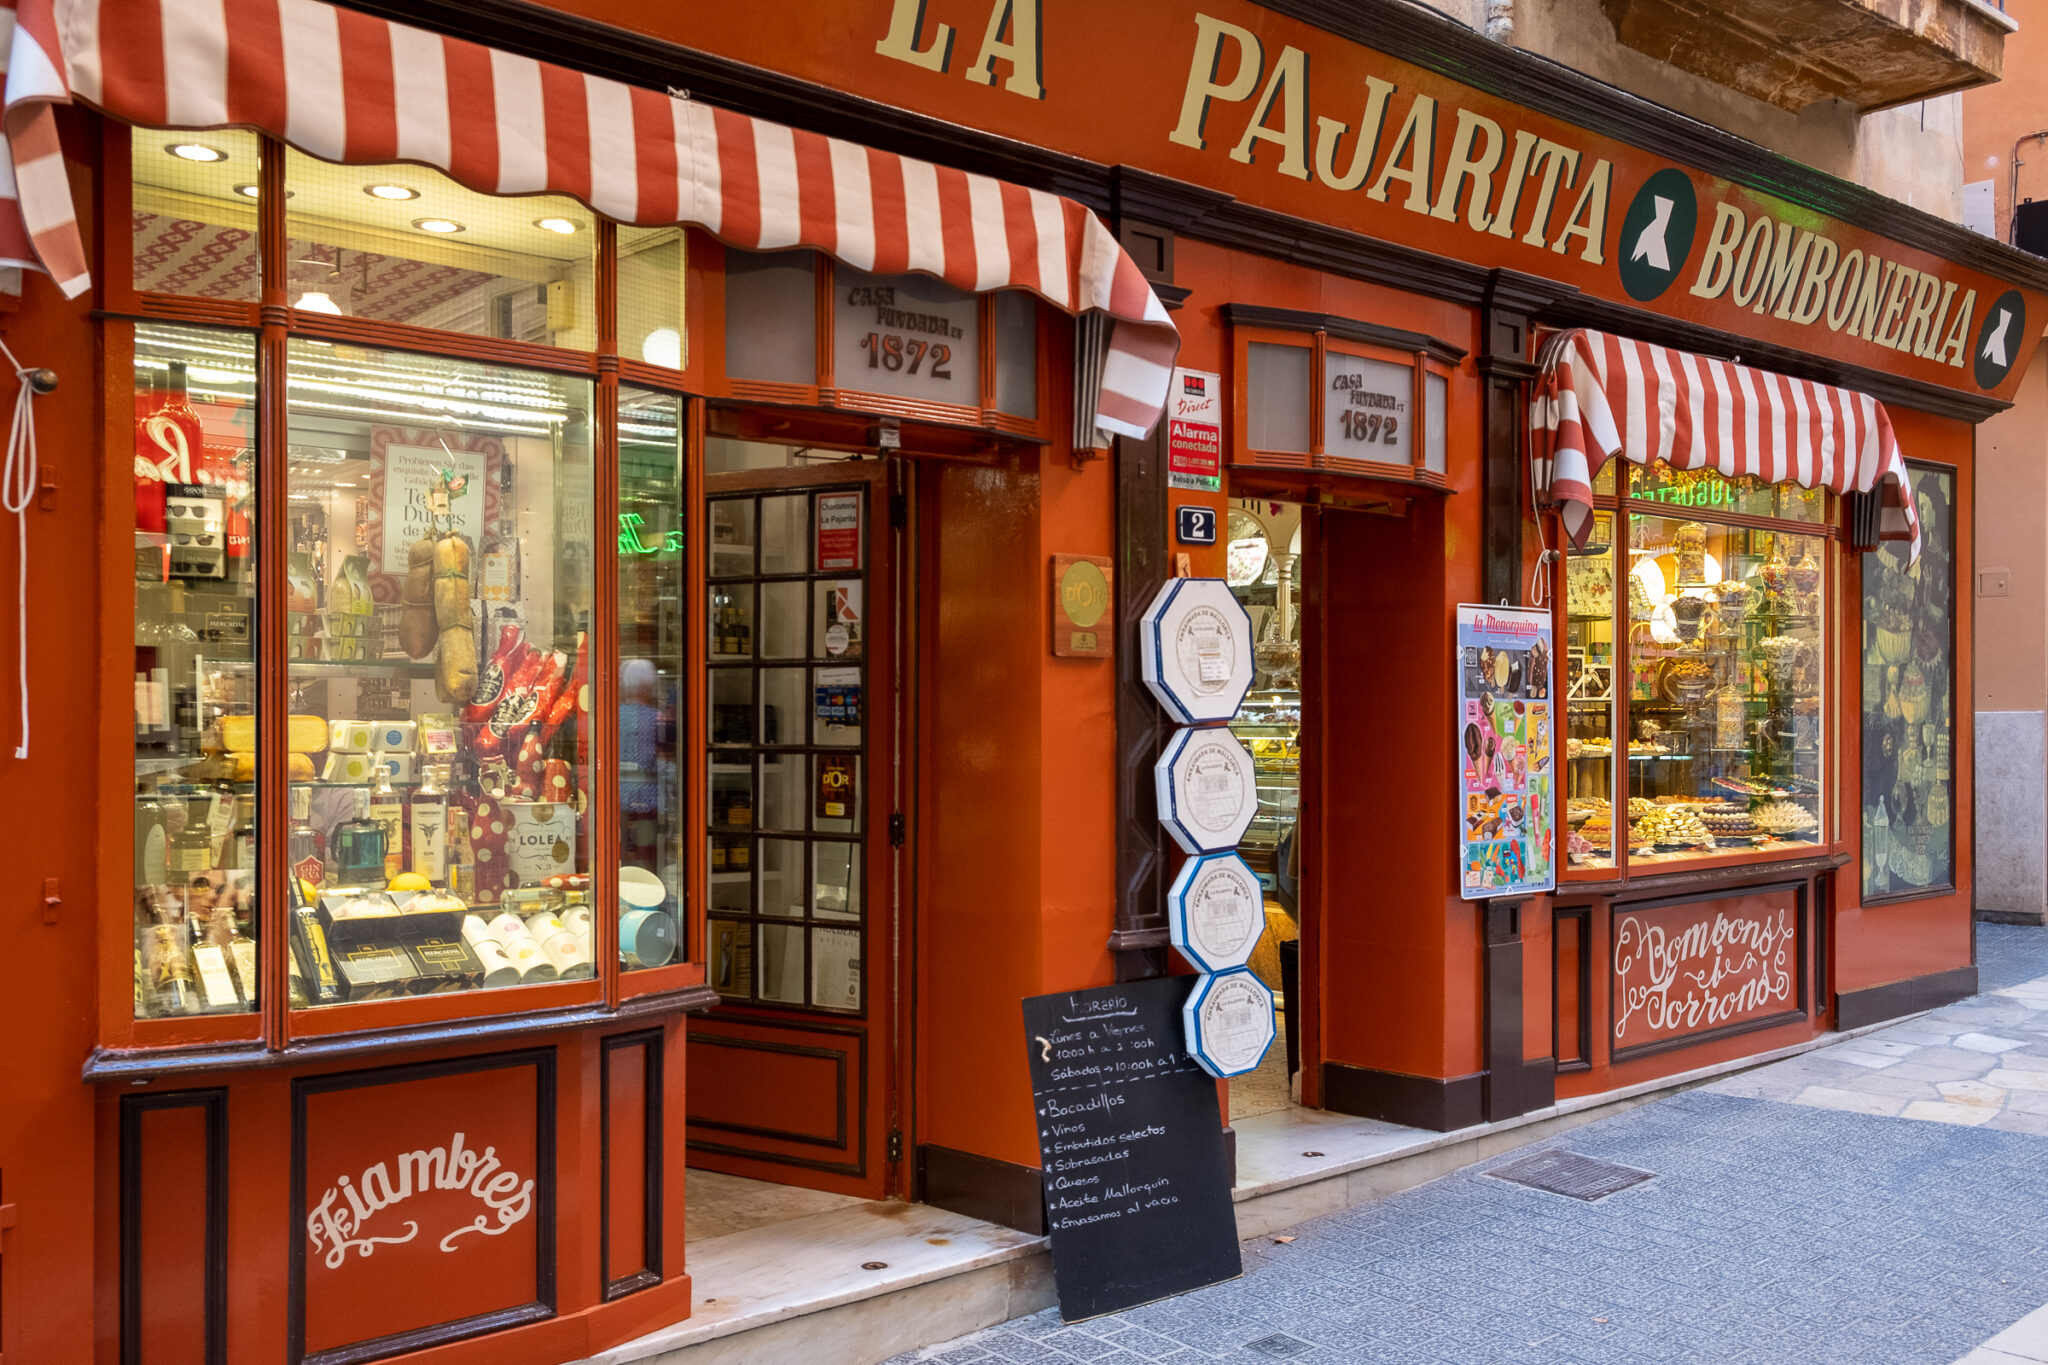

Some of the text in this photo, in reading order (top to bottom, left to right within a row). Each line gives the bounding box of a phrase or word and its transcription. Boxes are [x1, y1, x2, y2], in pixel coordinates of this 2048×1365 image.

[875, 0, 1616, 266] LA PAJARITA
[1689, 201, 1977, 368] BOMBONERIA
[848, 286, 895, 306] CASA
[876, 307, 950, 336] FUNDADA
[860, 332, 952, 380] 1872
[1332, 374, 1363, 390] CASA
[1177, 397, 1215, 415] Direct
[1350, 390, 1397, 410] FUNDADA
[1172, 423, 1217, 442] Alarma
[1340, 410, 1398, 445] 1872
[1172, 439, 1217, 453] conectada
[830, 514, 857, 525] Pajarita
[1191, 512, 1205, 539] 2
[403, 525, 419, 537] de
[1486, 613, 1538, 637] Menorquina
[823, 771, 849, 788] D'OR
[520, 834, 563, 846] LOLEA
[1640, 911, 1780, 984] Bombons
[1645, 960, 1774, 1030] Torrons
[1048, 1029, 1082, 1044] Lunes
[1090, 1031, 1100, 1039] a
[1051, 1065, 1101, 1081] Sábados
[1157, 1058, 1168, 1066] a
[1047, 1093, 1125, 1118] Bocadillos
[1051, 1123, 1086, 1137] Vinos
[1054, 1125, 1166, 1153] Embutidos selectos
[1055, 1150, 1130, 1171] Sobrasadas
[1055, 1175, 1100, 1190] Quesos
[1059, 1193, 1099, 1209] Aceite
[1127, 1201, 1140, 1214] al
